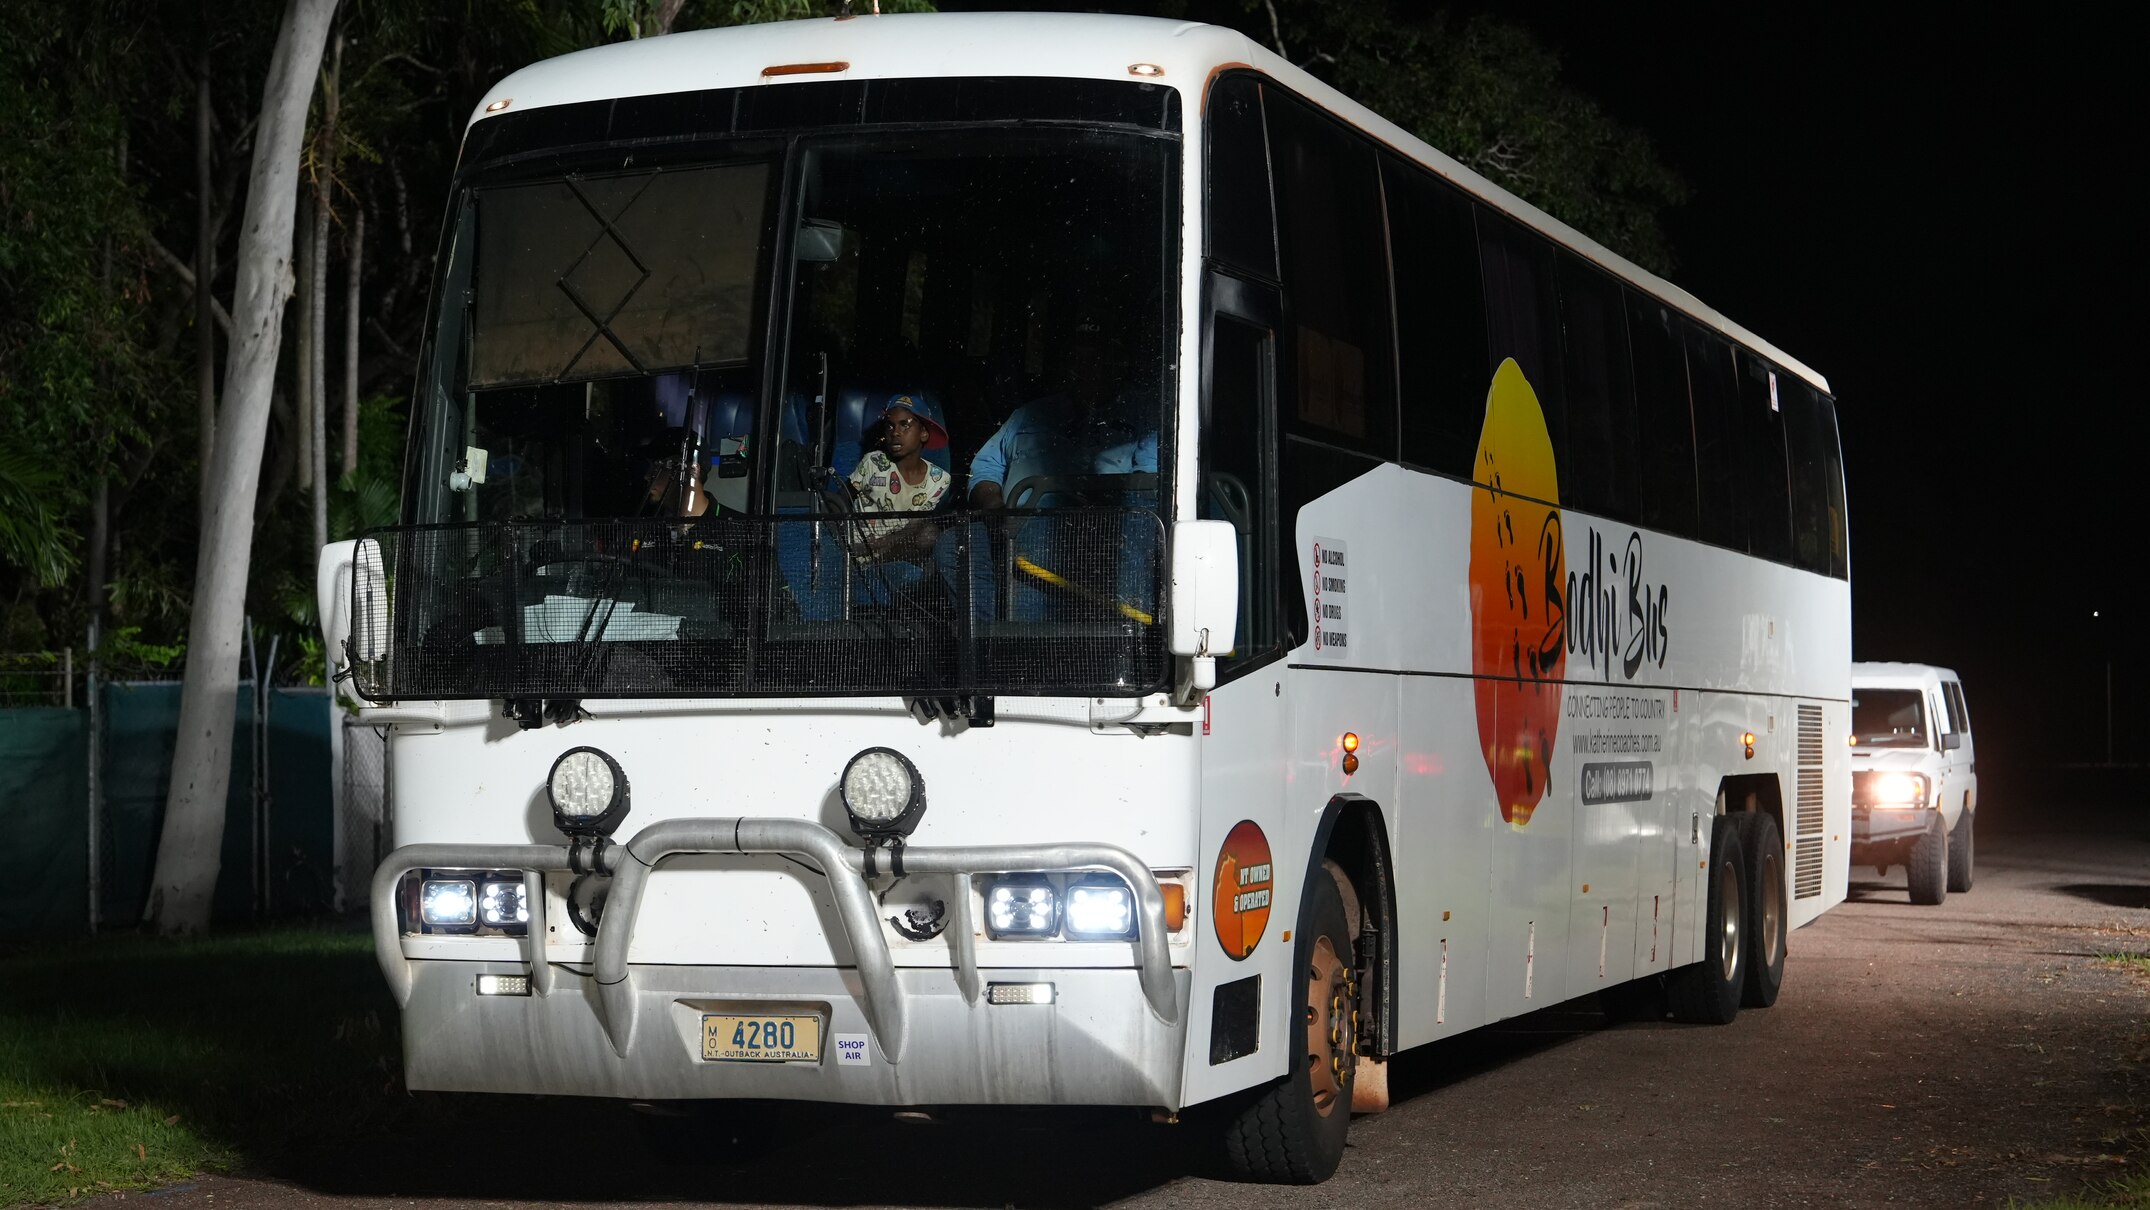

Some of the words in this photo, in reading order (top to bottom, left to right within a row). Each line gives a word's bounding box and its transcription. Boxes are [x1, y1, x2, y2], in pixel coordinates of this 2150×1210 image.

[1322, 549, 1328, 564] NO
[1328, 550, 1345, 566] ALCOHOL
[1322, 576, 1328, 591] NO
[1328, 577, 1346, 593] SMOKING
[1322, 604, 1328, 619] NO
[1329, 604, 1341, 619] DRUGS
[1623, 531, 1667, 679] Bus
[1323, 631, 1329, 646] NO
[1329, 632, 1347, 647] WEAPONS
[1567, 695, 1609, 719] CONNECTING
[1609, 696, 1630, 719] PEOPLE
[1631, 698, 1639, 719] TO
[1640, 698, 1665, 719] COUNTRY
[1603, 765, 1616, 800] (08)
[1240, 867, 1249, 886] NT
[1250, 863, 1271, 884] OWNED
[1239, 889, 1270, 912] OPERATED
[732, 1020, 795, 1049] 4280
[838, 1040, 865, 1050] SHOP
[845, 1051, 861, 1060] AIR
